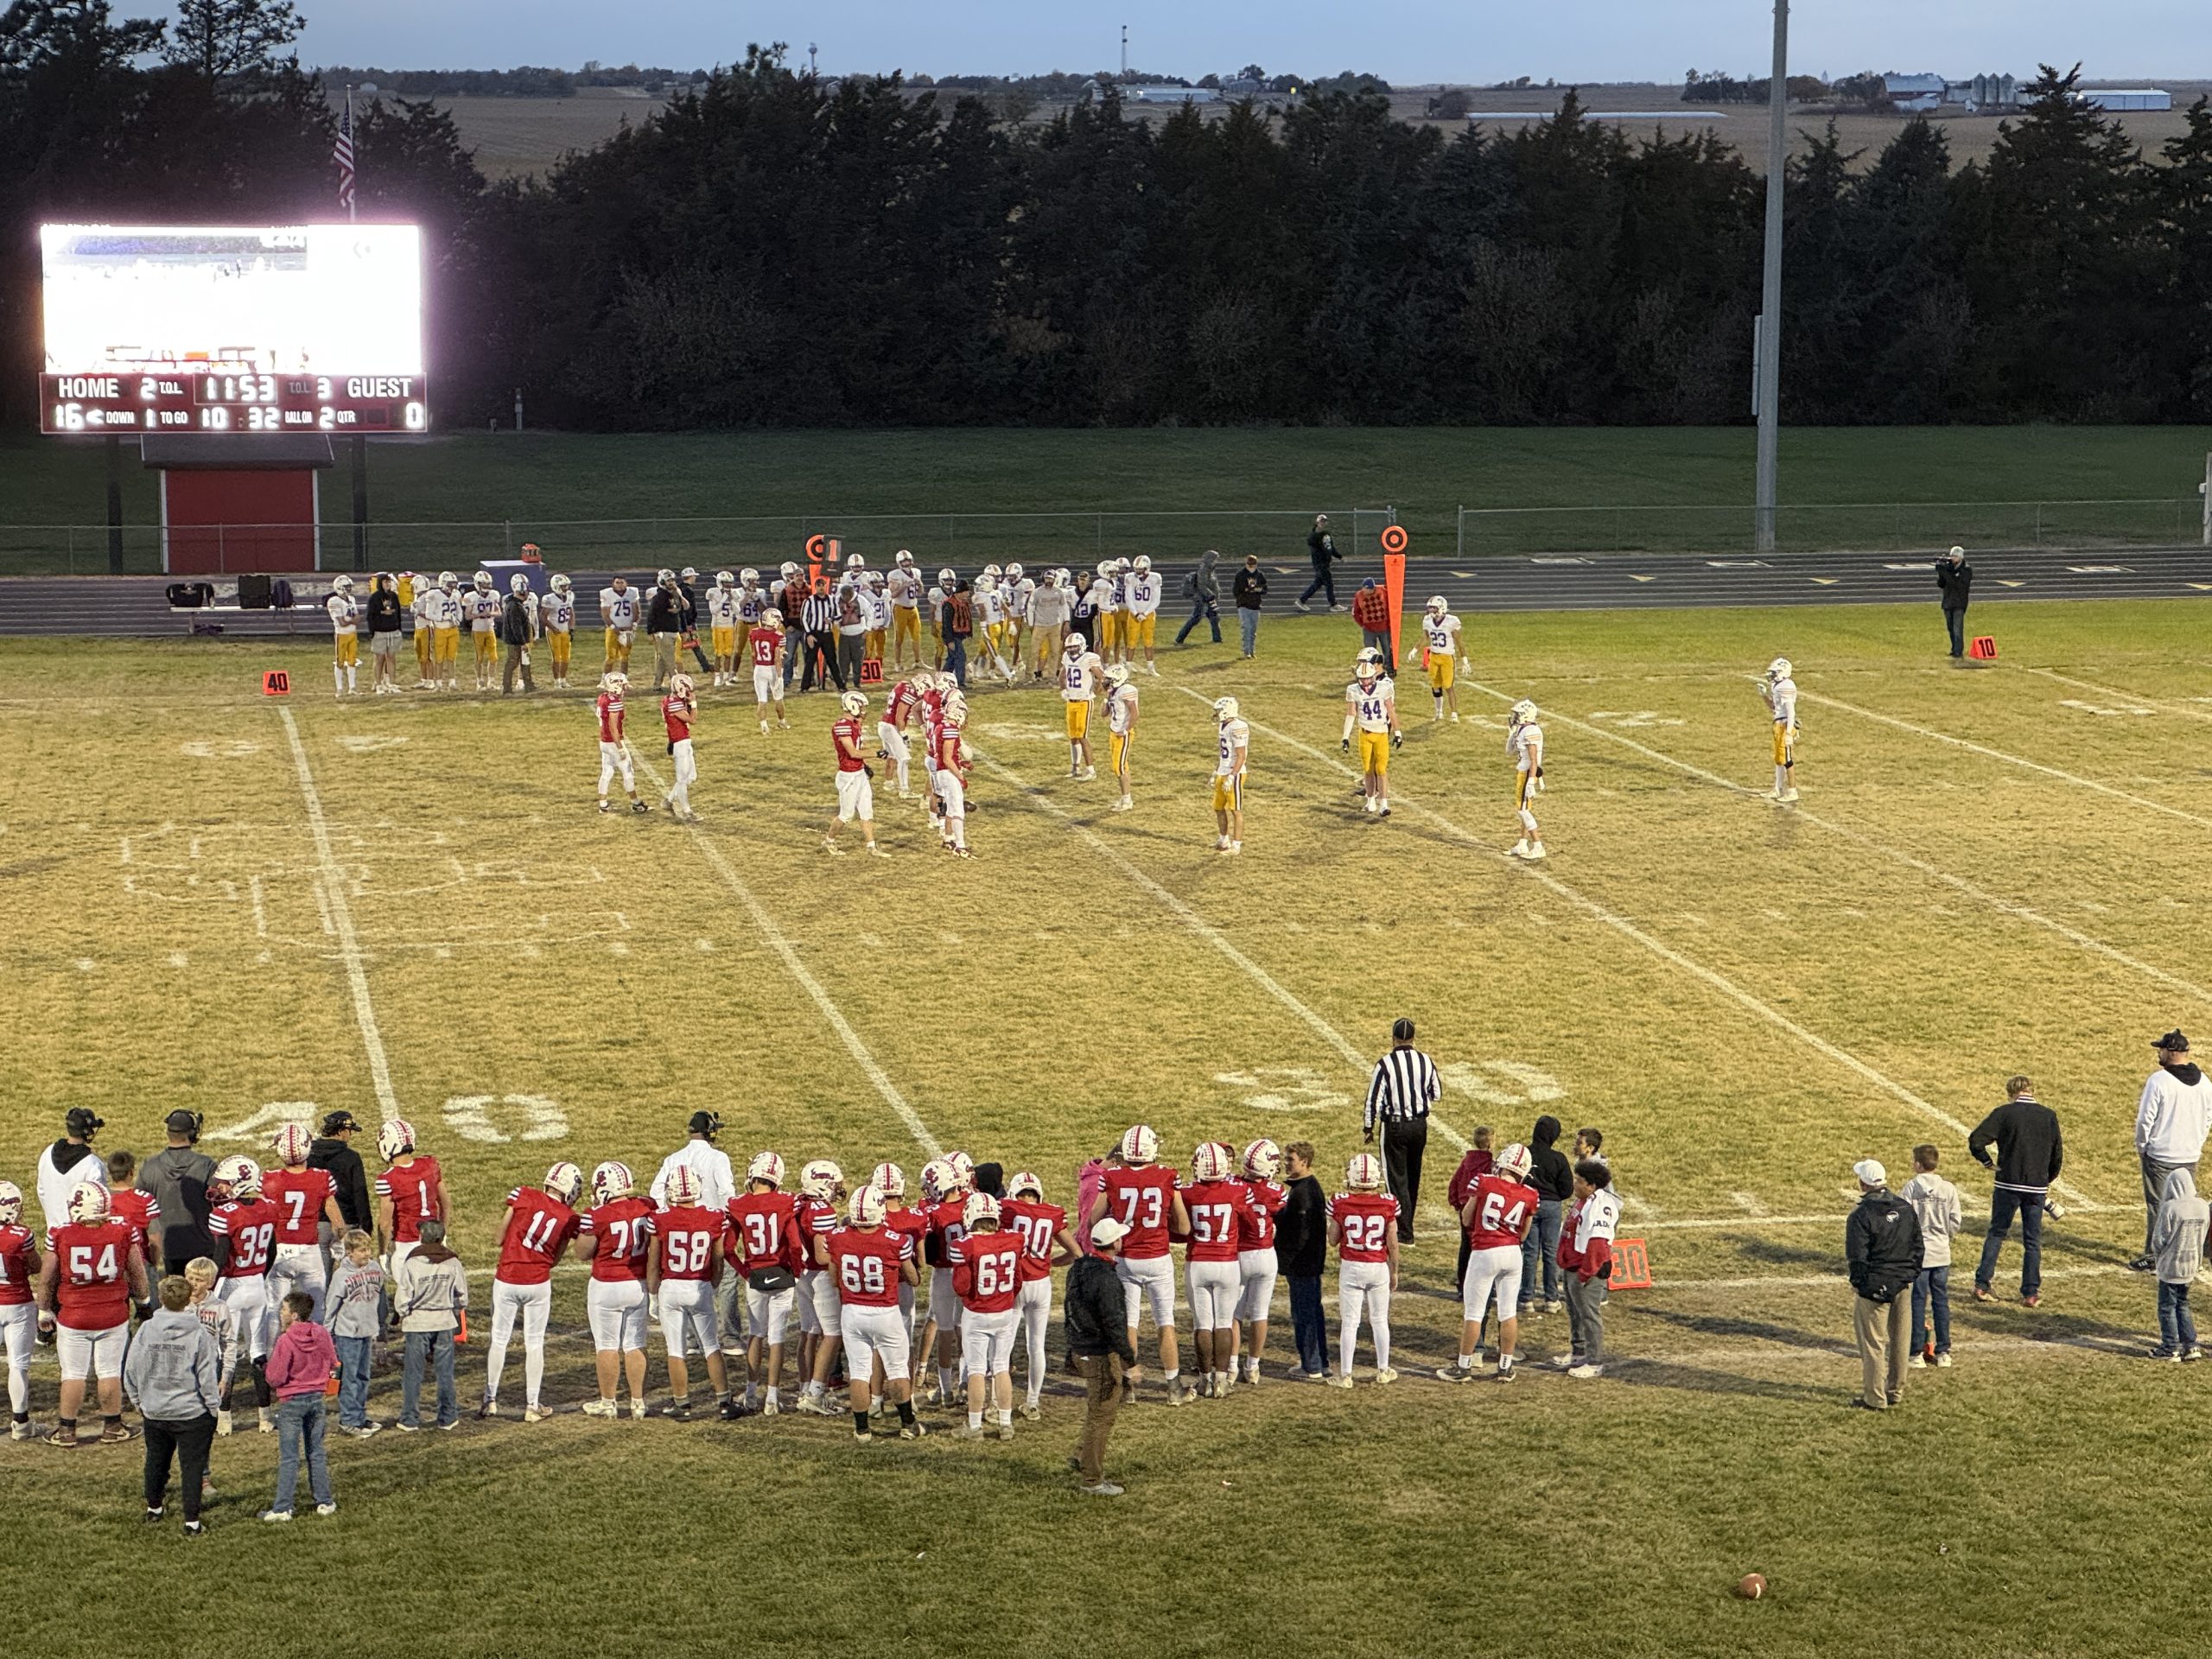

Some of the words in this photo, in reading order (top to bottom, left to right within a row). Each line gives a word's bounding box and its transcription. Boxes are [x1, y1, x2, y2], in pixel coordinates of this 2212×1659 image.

[59, 378, 119, 397] HOME
[141, 377, 156, 399] 2
[318, 377, 332, 399] 3
[347, 378, 412, 397] GUEST
[55, 404, 84, 429] 16
[106, 411, 134, 424] DOWN
[146, 408, 156, 428] 1
[161, 411, 174, 423] TO
[175, 411, 188, 424] GO
[202, 407, 227, 429] 10
[249, 407, 279, 429] 32
[285, 410, 302, 423] BALL
[302, 410, 312, 423] ON
[320, 407, 334, 429] 2
[338, 410, 356, 423] QTR
[406, 403, 423, 429] 0
[829, 539, 837, 561] 1
[1135, 587, 1150, 601] 60
[614, 601, 631, 617] 75
[721, 603, 730, 617] 5
[874, 603, 886, 620] 21
[754, 639, 772, 662] 13
[1430, 632, 1447, 647] 23
[1978, 639, 1995, 658] 10
[267, 672, 288, 691] 40
[861, 663, 880, 679] 30
[1066, 668, 1082, 689] 42
[1363, 700, 1382, 721] 44
[417, 1179, 431, 1217] 1
[1120, 1187, 1163, 1229] 73
[284, 1191, 306, 1230] 7
[1482, 1192, 1526, 1234] 64
[521, 1210, 558, 1253] 11
[746, 1212, 779, 1255] 31
[1192, 1204, 1233, 1243] 57
[1344, 1215, 1385, 1250] 22
[235, 1223, 275, 1268] 39
[609, 1217, 648, 1259] 70
[668, 1230, 710, 1273] 58
[70, 1244, 118, 1285] 54
[841, 1254, 884, 1294] 68
[977, 1251, 1017, 1295] 63
[1611, 1244, 1647, 1284] 30
